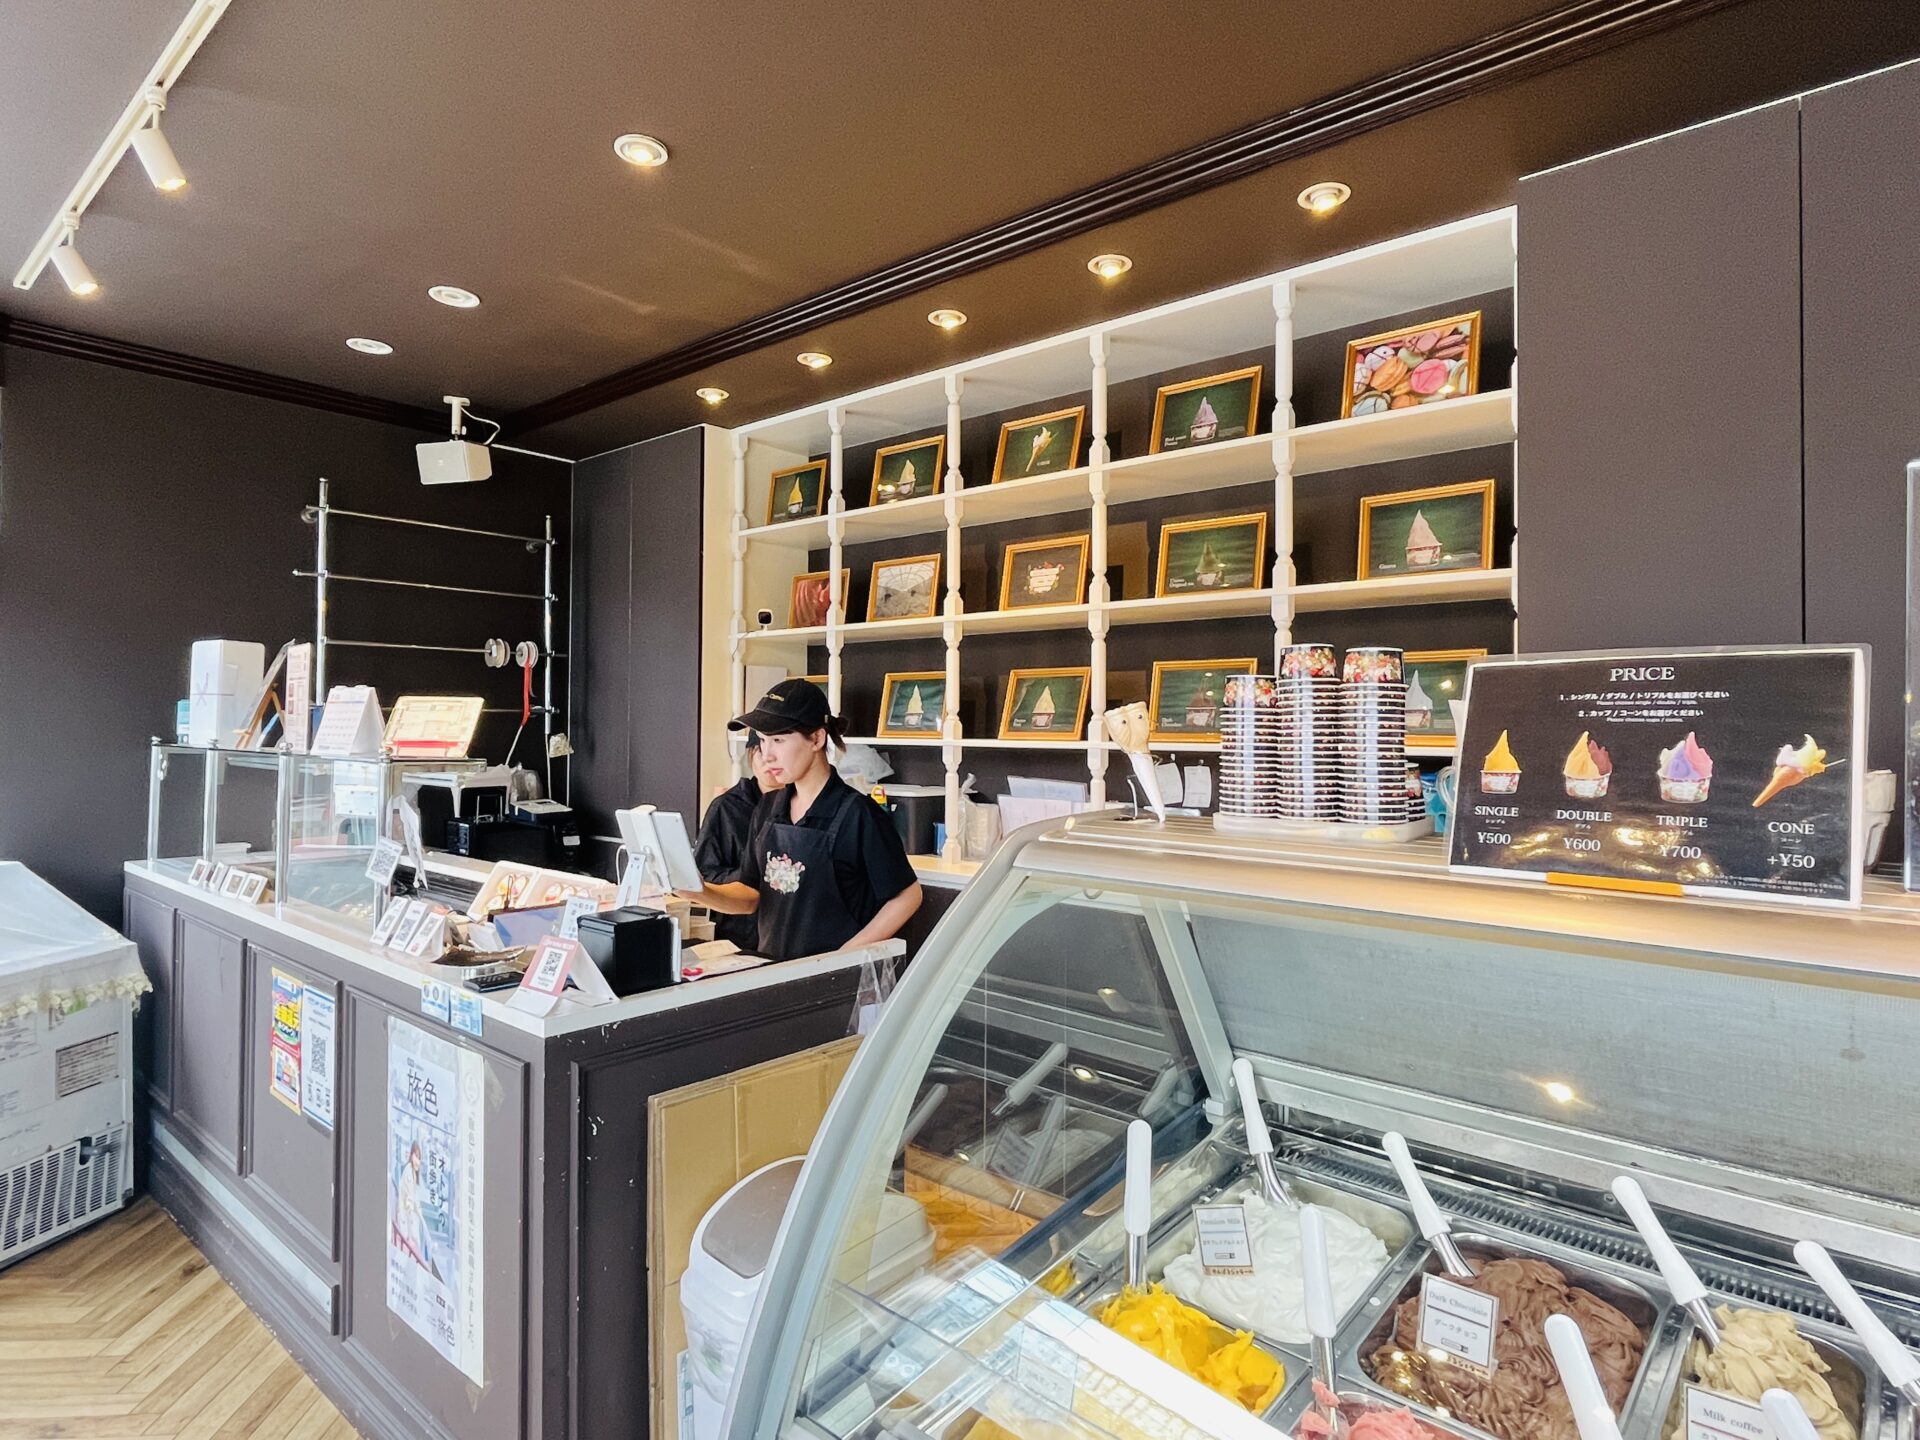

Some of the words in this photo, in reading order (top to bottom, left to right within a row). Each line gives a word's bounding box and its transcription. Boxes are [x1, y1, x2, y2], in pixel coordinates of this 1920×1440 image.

[1609, 666, 1675, 682] PRICE
[1474, 806, 1519, 817] SINGLE
[1556, 809, 1612, 822] DOUBLE
[1656, 815, 1708, 828] TRIPLE
[1768, 821, 1815, 835] CONE
[1477, 832, 1511, 845] ¥500
[1563, 837, 1600, 851] ¥600
[1659, 845, 1701, 859] ¥700
[1767, 853, 1816, 869] +¥50
[407, 1068, 439, 1117] 旅色
[1703, 1407, 1727, 1423] Milk
[1730, 1419, 1764, 1434] coffee
